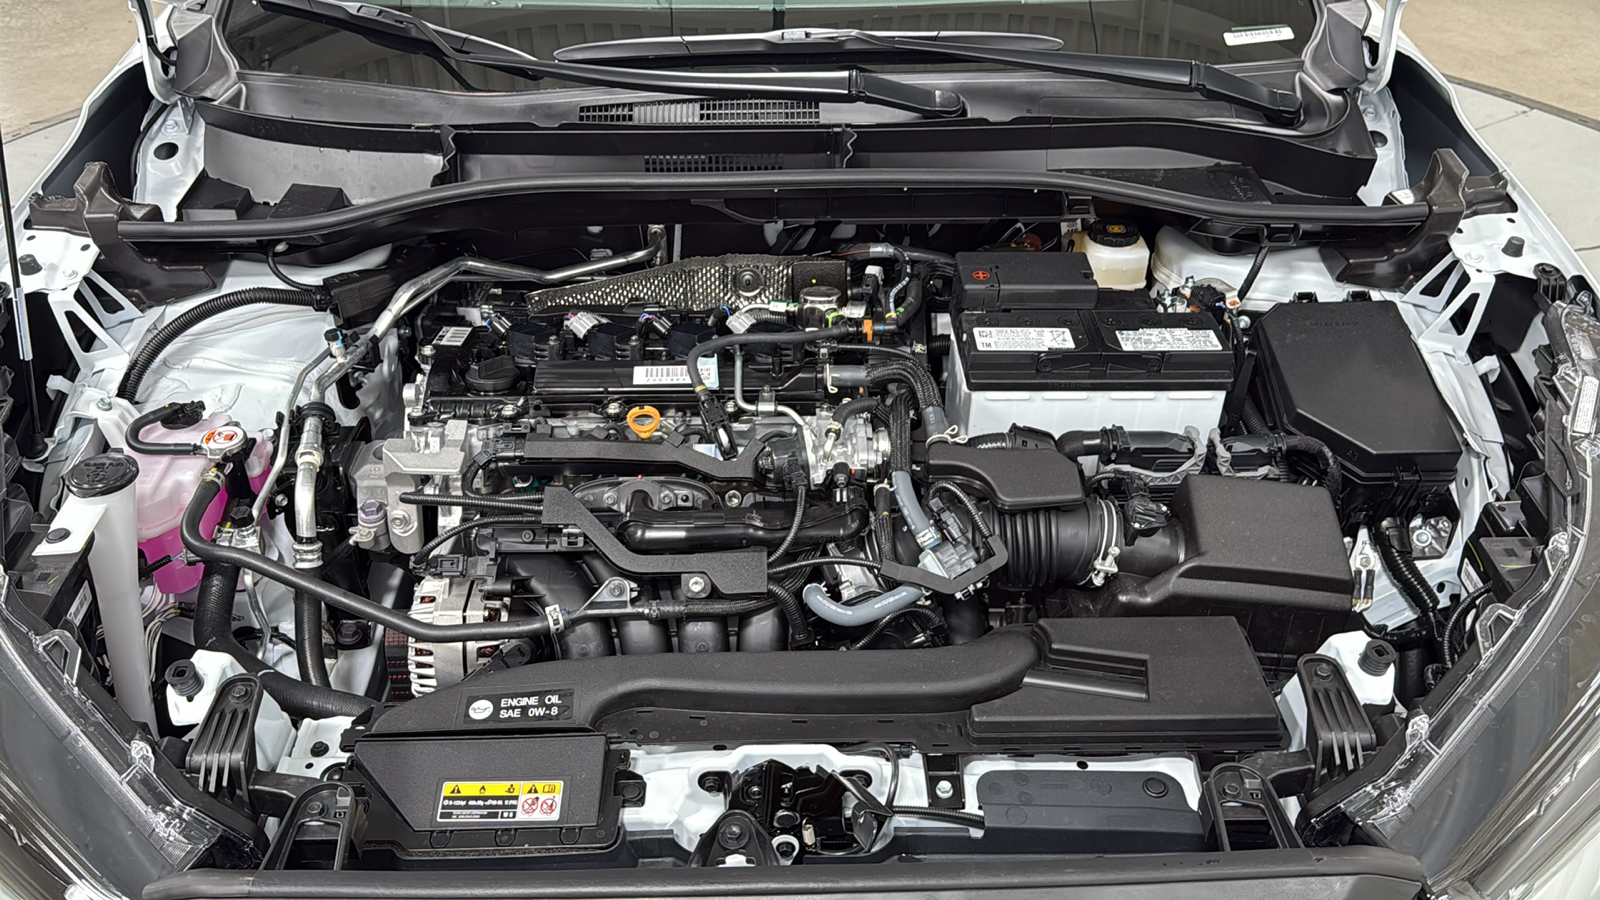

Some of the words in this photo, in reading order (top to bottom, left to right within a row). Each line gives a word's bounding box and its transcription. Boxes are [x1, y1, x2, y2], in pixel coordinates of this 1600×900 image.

[501, 696, 539, 707] ENGINE
[544, 695, 562, 704] OIL
[499, 708, 521, 718] SAE
[528, 706, 558, 717] 0W-8
